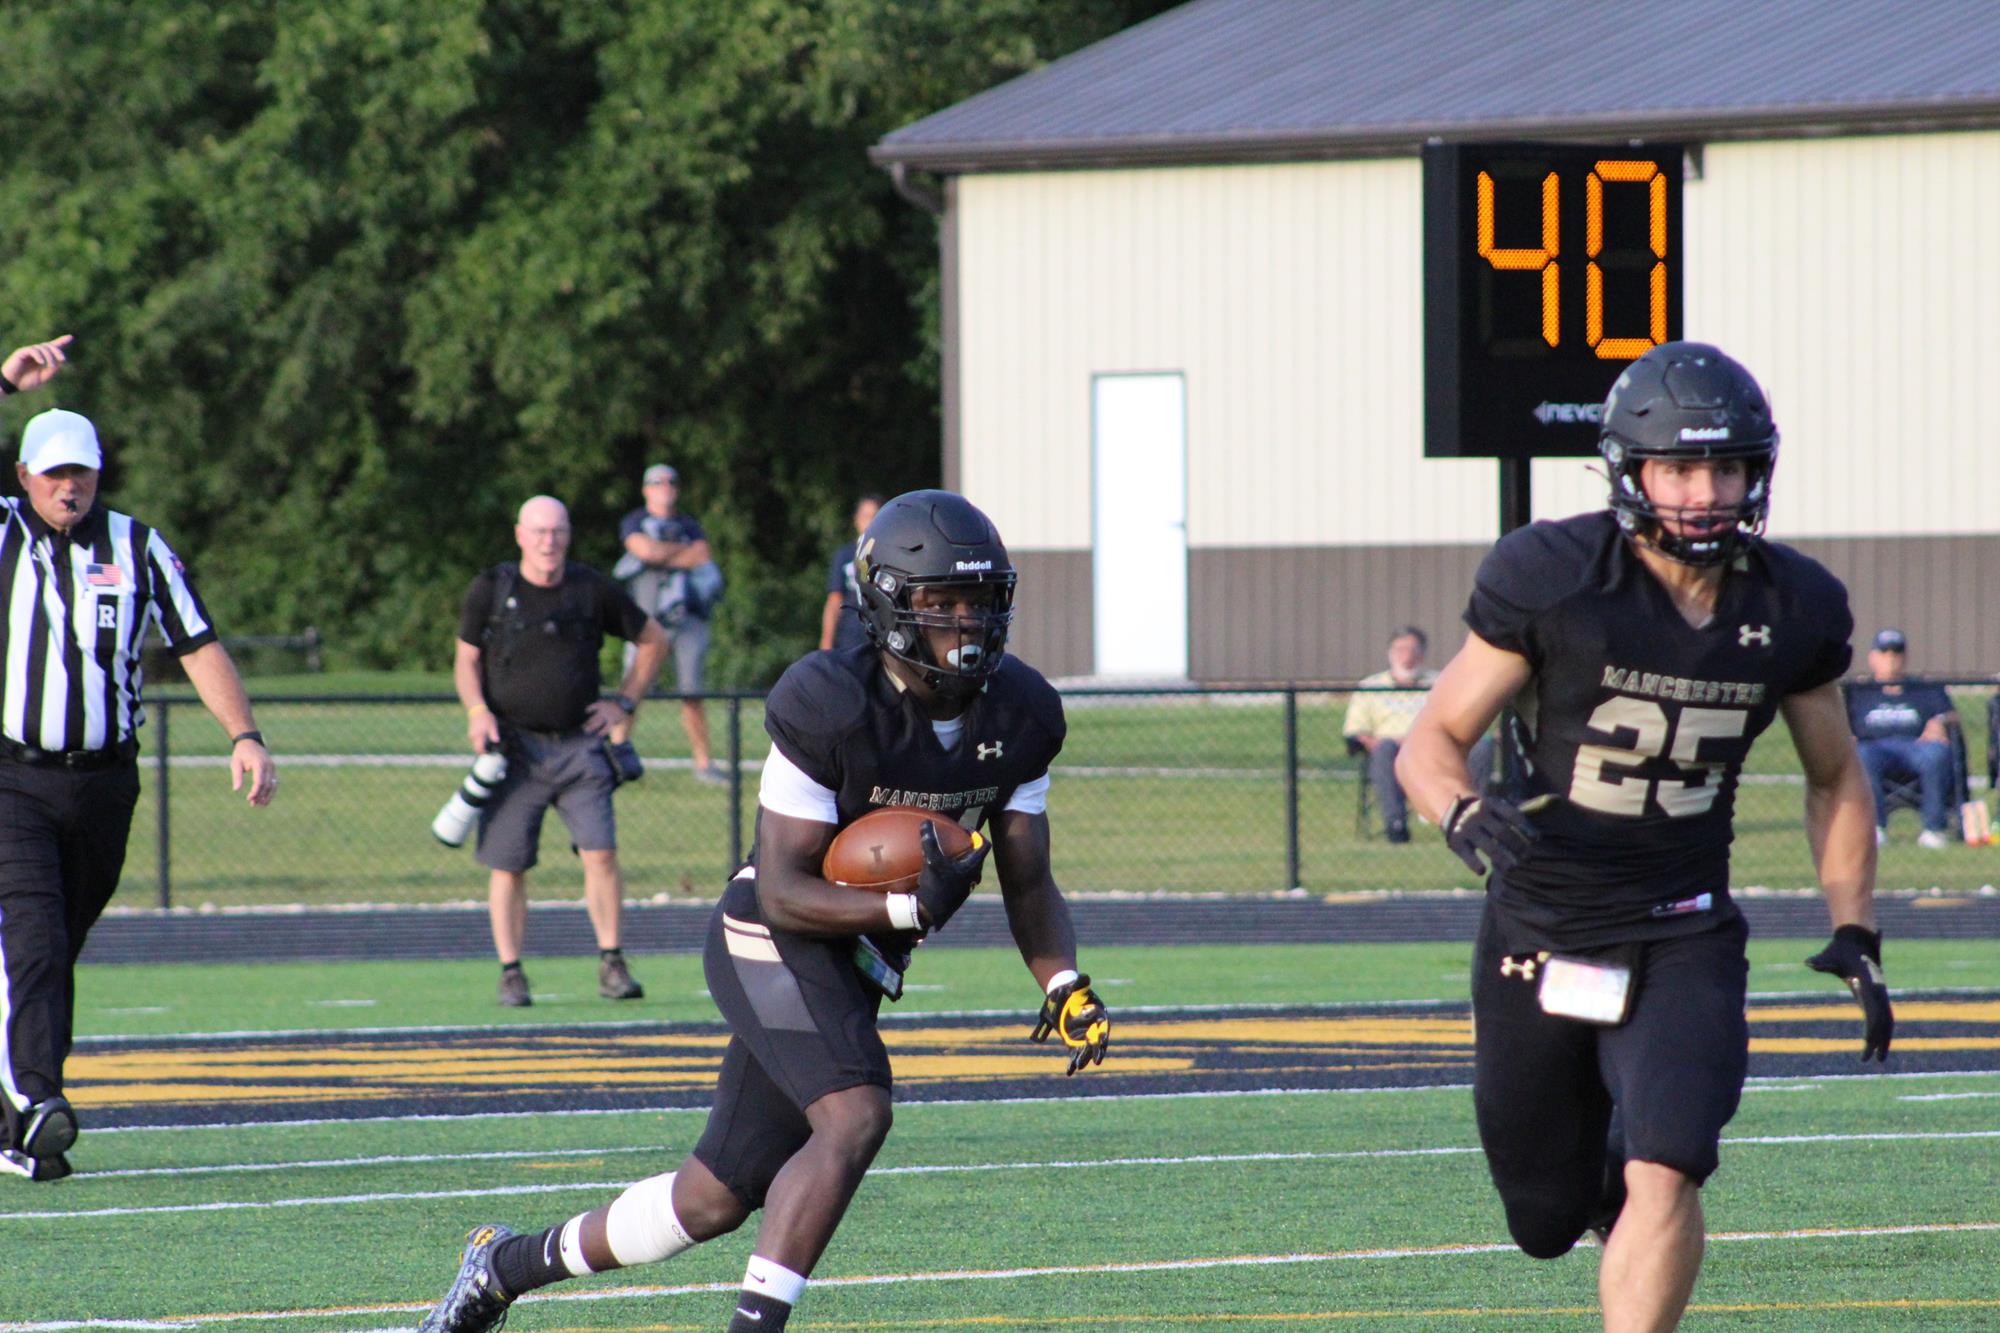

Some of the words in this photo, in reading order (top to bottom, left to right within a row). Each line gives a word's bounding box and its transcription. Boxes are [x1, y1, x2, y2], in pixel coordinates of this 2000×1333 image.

[1477, 160, 1667, 359] 40
[1546, 402, 1605, 423] NEVC
[1680, 427, 1729, 441] Riddell
[955, 560, 992, 571] Riddell
[98, 604, 116, 629] R
[1601, 665, 1766, 704] MANCHESTER
[1568, 695, 1749, 817] 25
[869, 785, 999, 811] MANCHESTER
